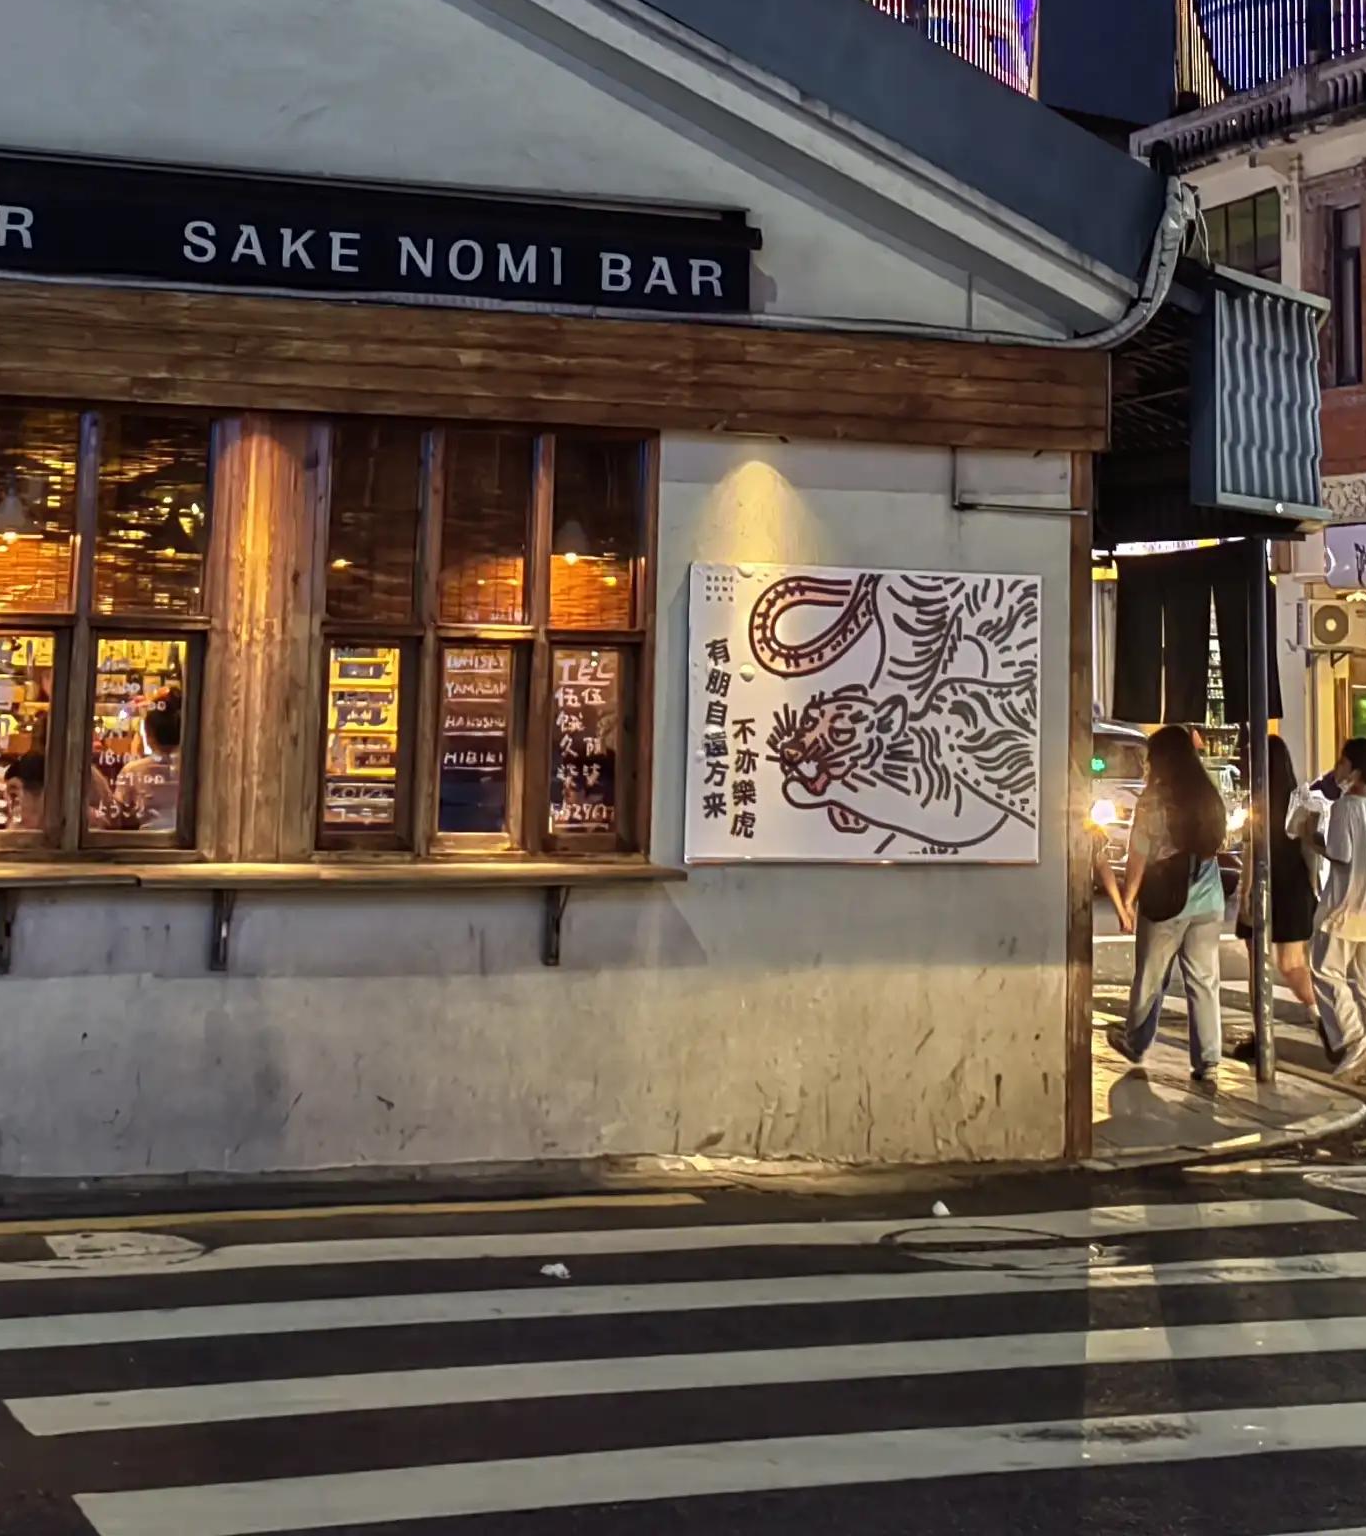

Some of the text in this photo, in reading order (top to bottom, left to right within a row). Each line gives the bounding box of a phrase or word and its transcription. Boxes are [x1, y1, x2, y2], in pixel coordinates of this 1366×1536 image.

[183, 220, 724, 297] SAKE NOMI BAR
[557, 658, 615, 682] TEL
